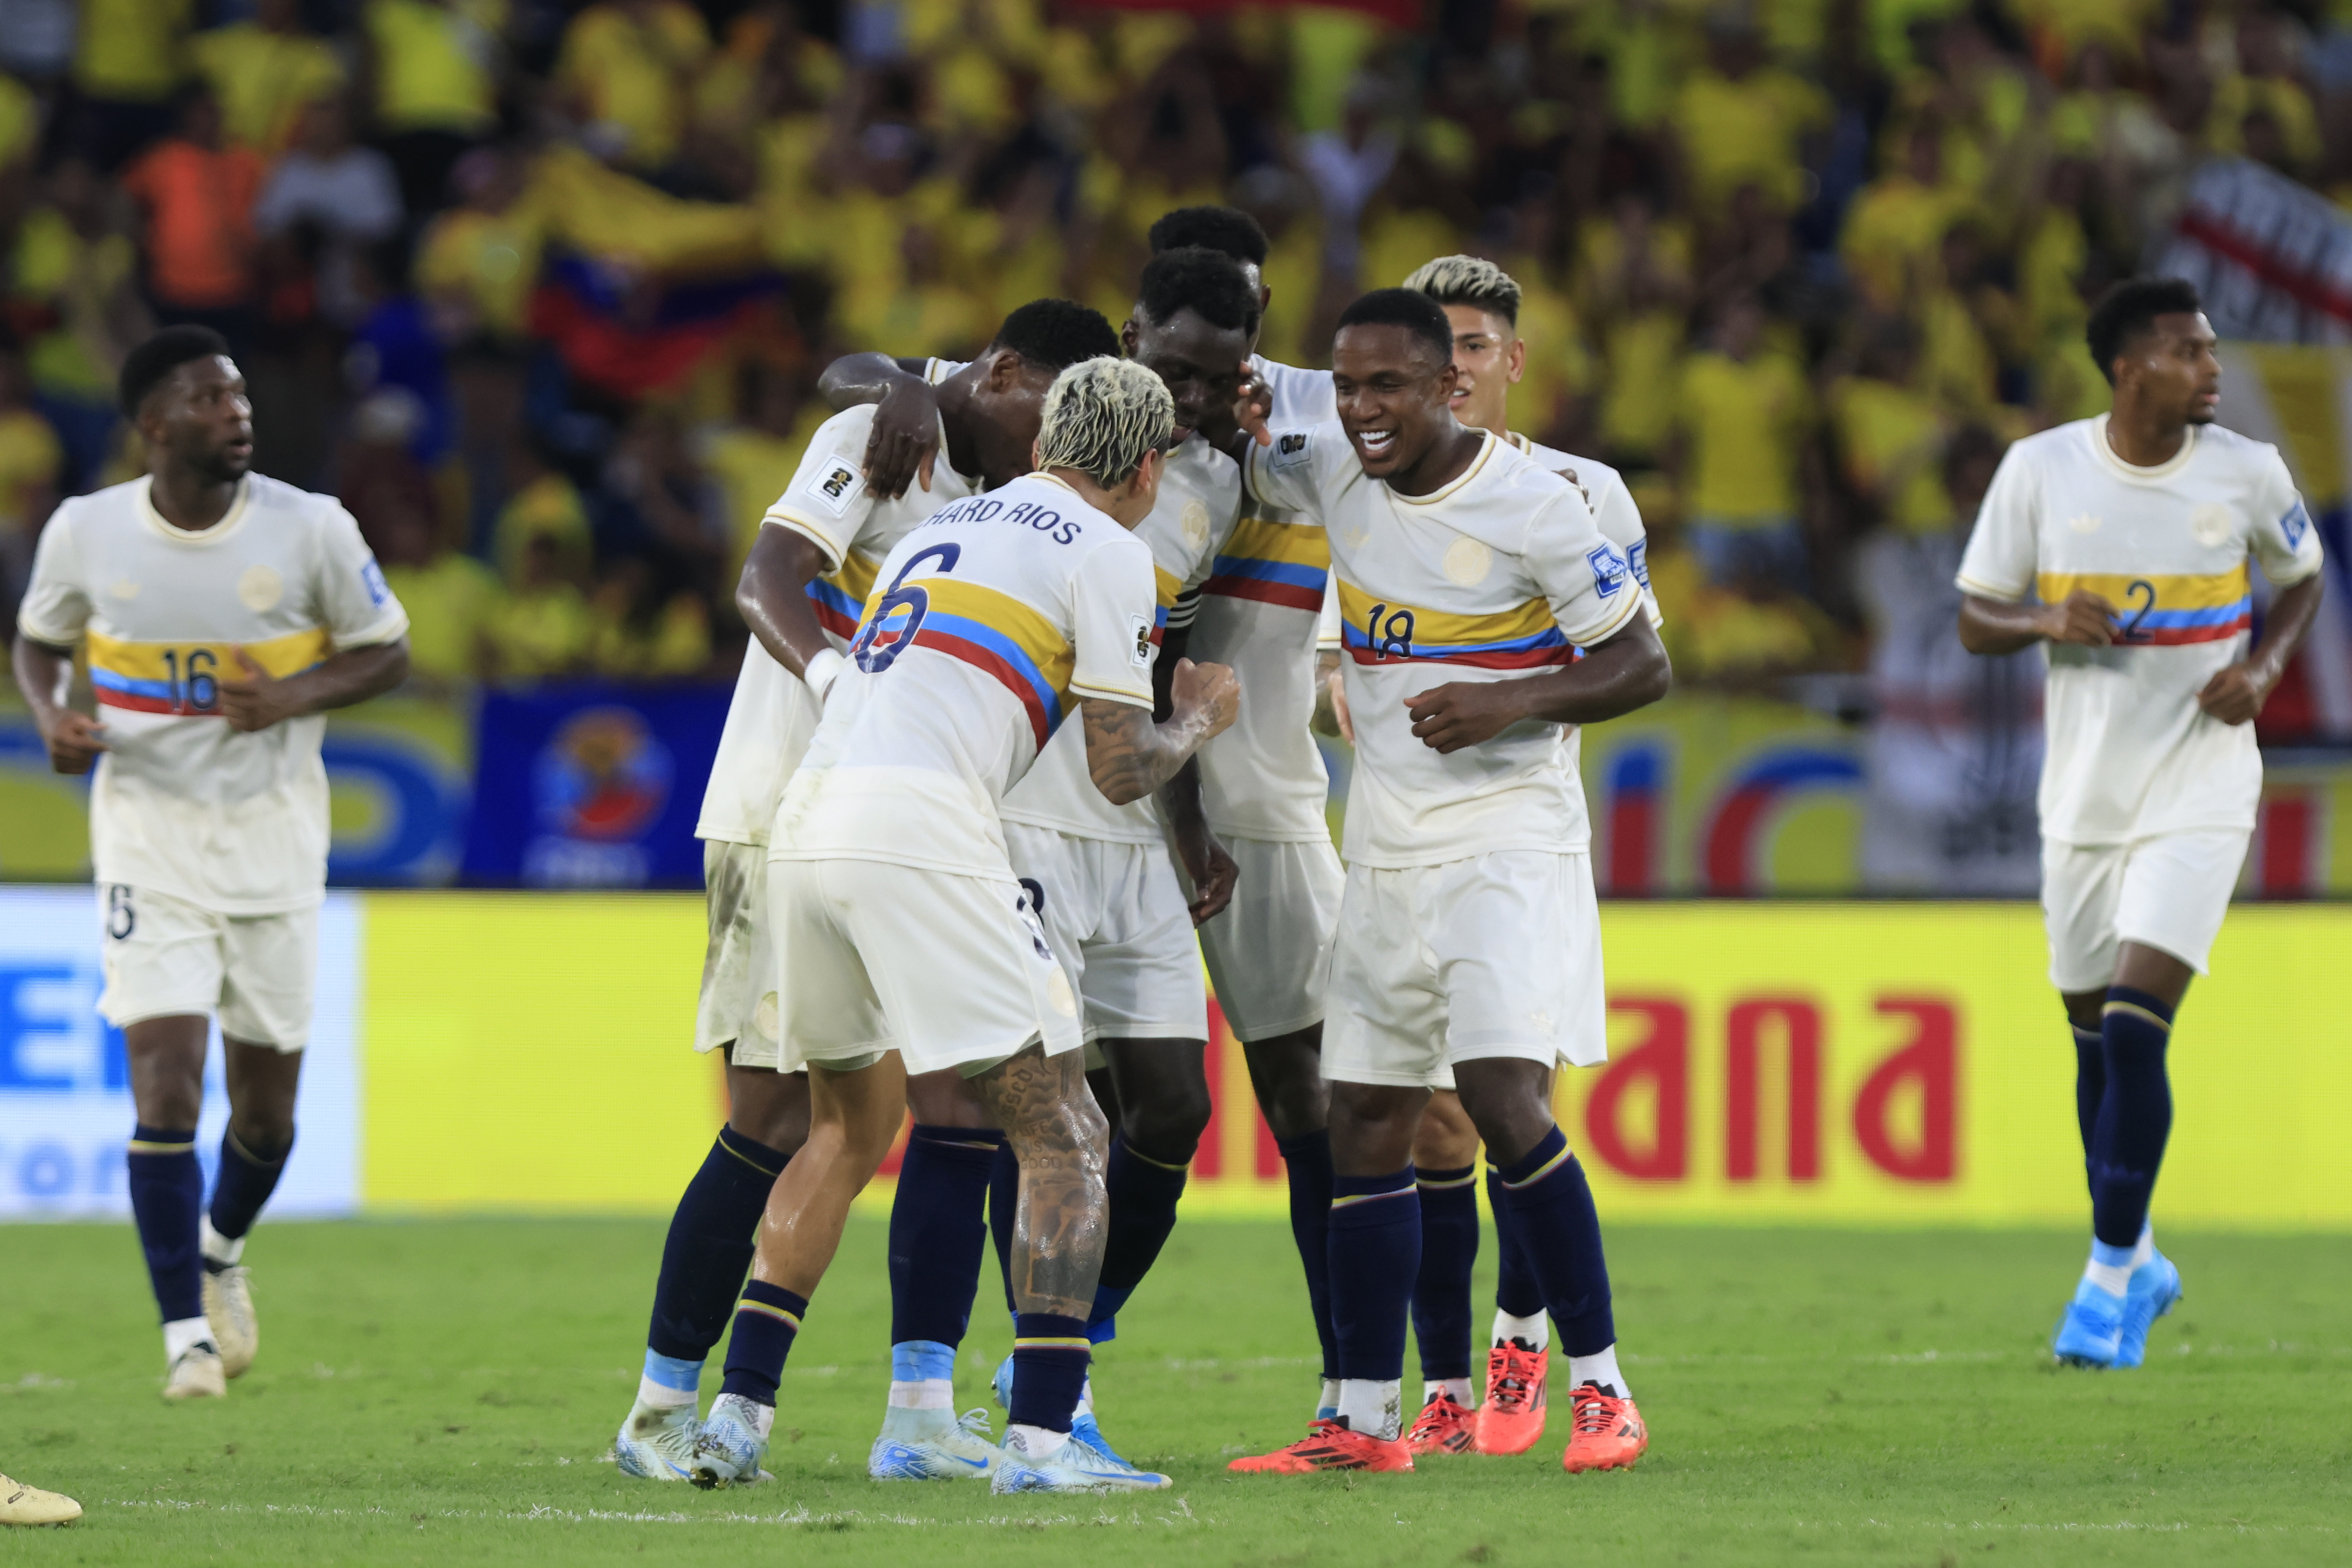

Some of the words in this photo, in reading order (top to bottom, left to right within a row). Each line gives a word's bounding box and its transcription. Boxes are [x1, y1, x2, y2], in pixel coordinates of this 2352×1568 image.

[911, 499, 1004, 531] HARD
[1002, 503, 1082, 544] RIOS
[854, 542, 961, 674] 6
[1368, 603, 1415, 659] 18
[2125, 581, 2157, 641] 2
[162, 647, 219, 709] 16
